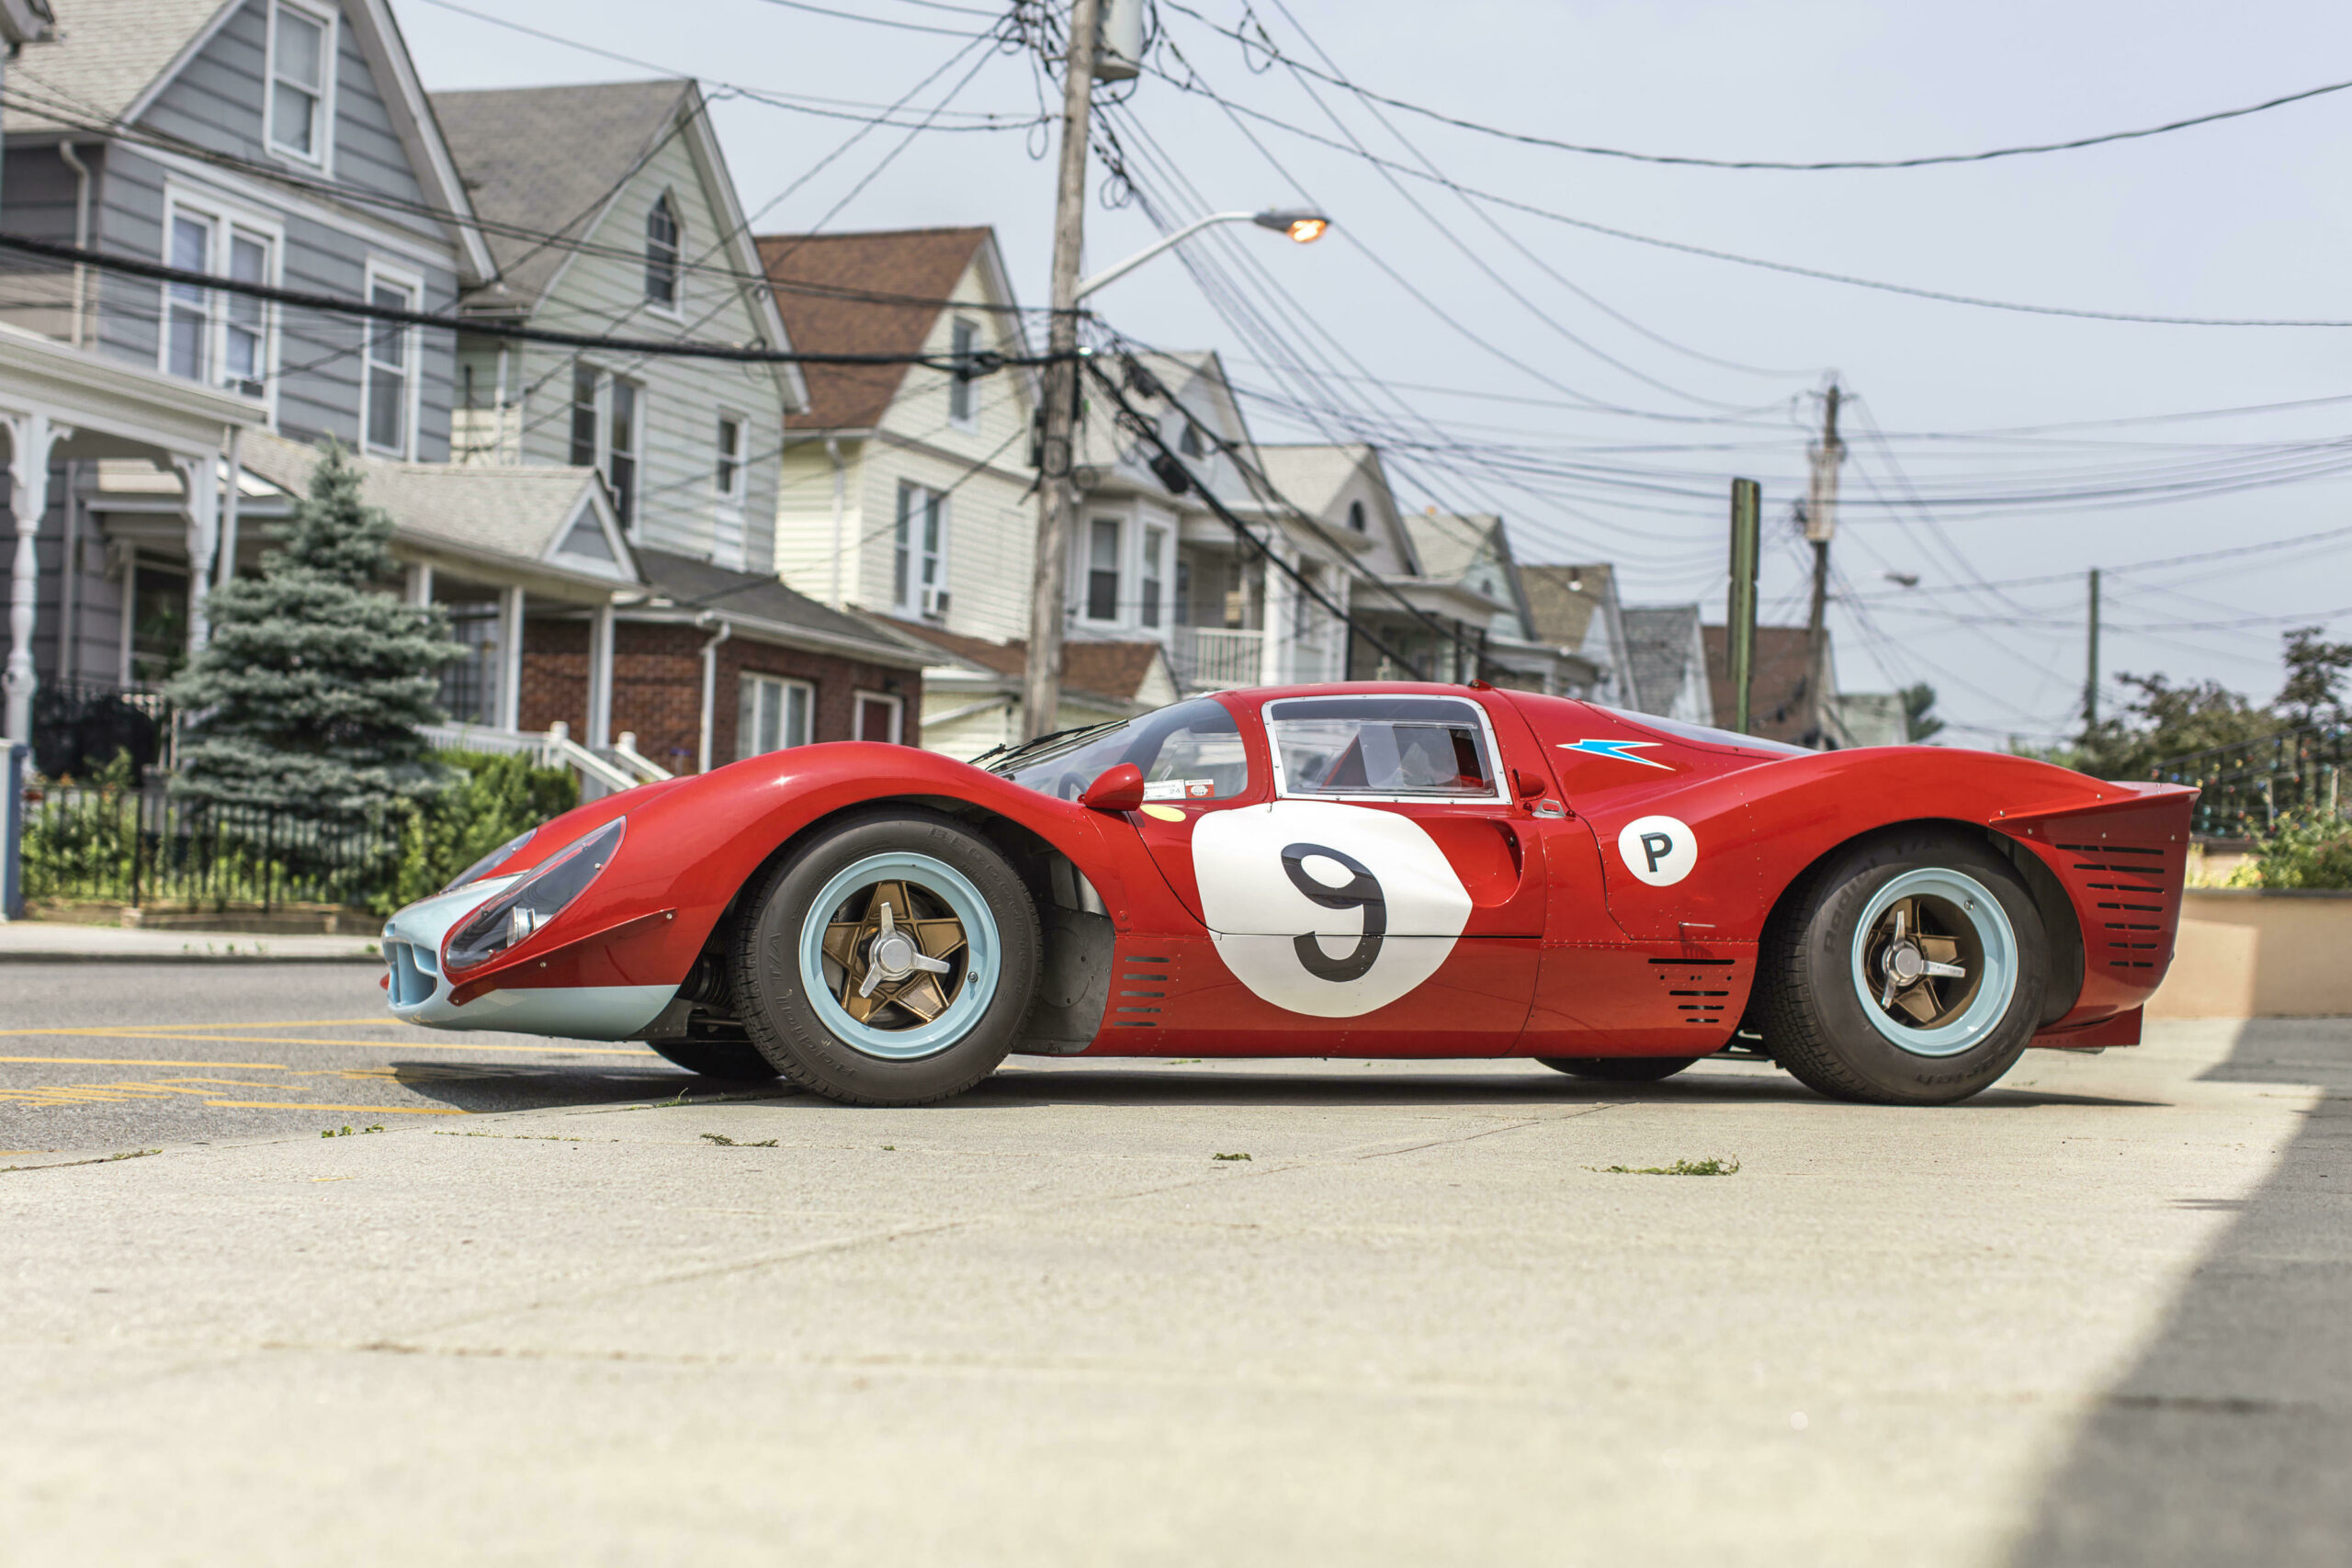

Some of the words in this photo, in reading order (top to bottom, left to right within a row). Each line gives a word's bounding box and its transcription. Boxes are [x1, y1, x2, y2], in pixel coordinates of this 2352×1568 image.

[1640, 831, 1673, 873] P
[1281, 842, 1387, 982] 9
[1823, 857, 1877, 955] Radial
[768, 931, 783, 987] T/A
[774, 994, 859, 1079] Radial
